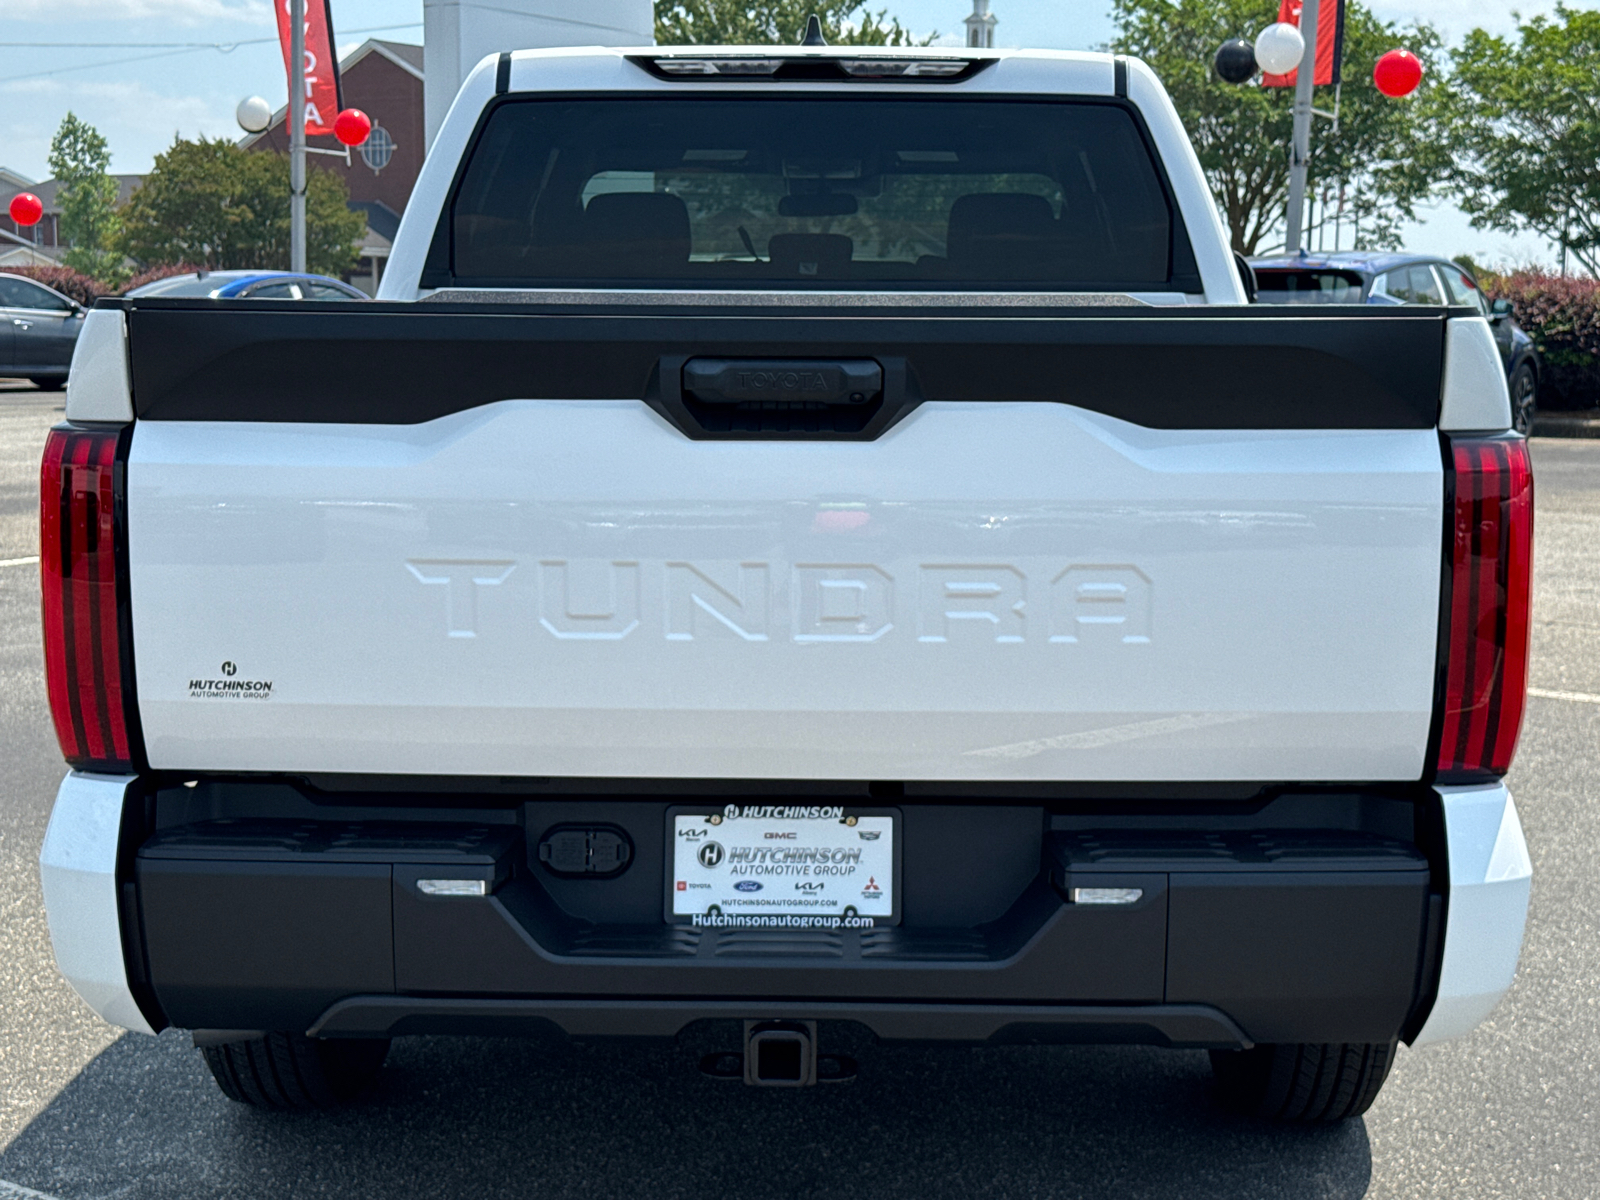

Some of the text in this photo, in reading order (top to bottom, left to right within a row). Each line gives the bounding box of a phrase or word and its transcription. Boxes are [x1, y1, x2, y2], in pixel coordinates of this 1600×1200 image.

[737, 371, 828, 391] TOYOTA
[404, 557, 1154, 646] TUNDRA
[188, 679, 273, 691] HUTCHINSON
[190, 690, 270, 699] AUTOMOTIVE GROUP
[742, 805, 844, 819] HUTCHINSON
[763, 832, 798, 840] GMC
[728, 846, 863, 865] HUTCHINSON
[730, 864, 857, 876] AUTOMOTIVE GROUP
[738, 882, 759, 891] Ford
[721, 898, 838, 907] HUTCHINSONAUTOGROUP.COM
[692, 912, 875, 929] Hutchinsonautogroup.com
